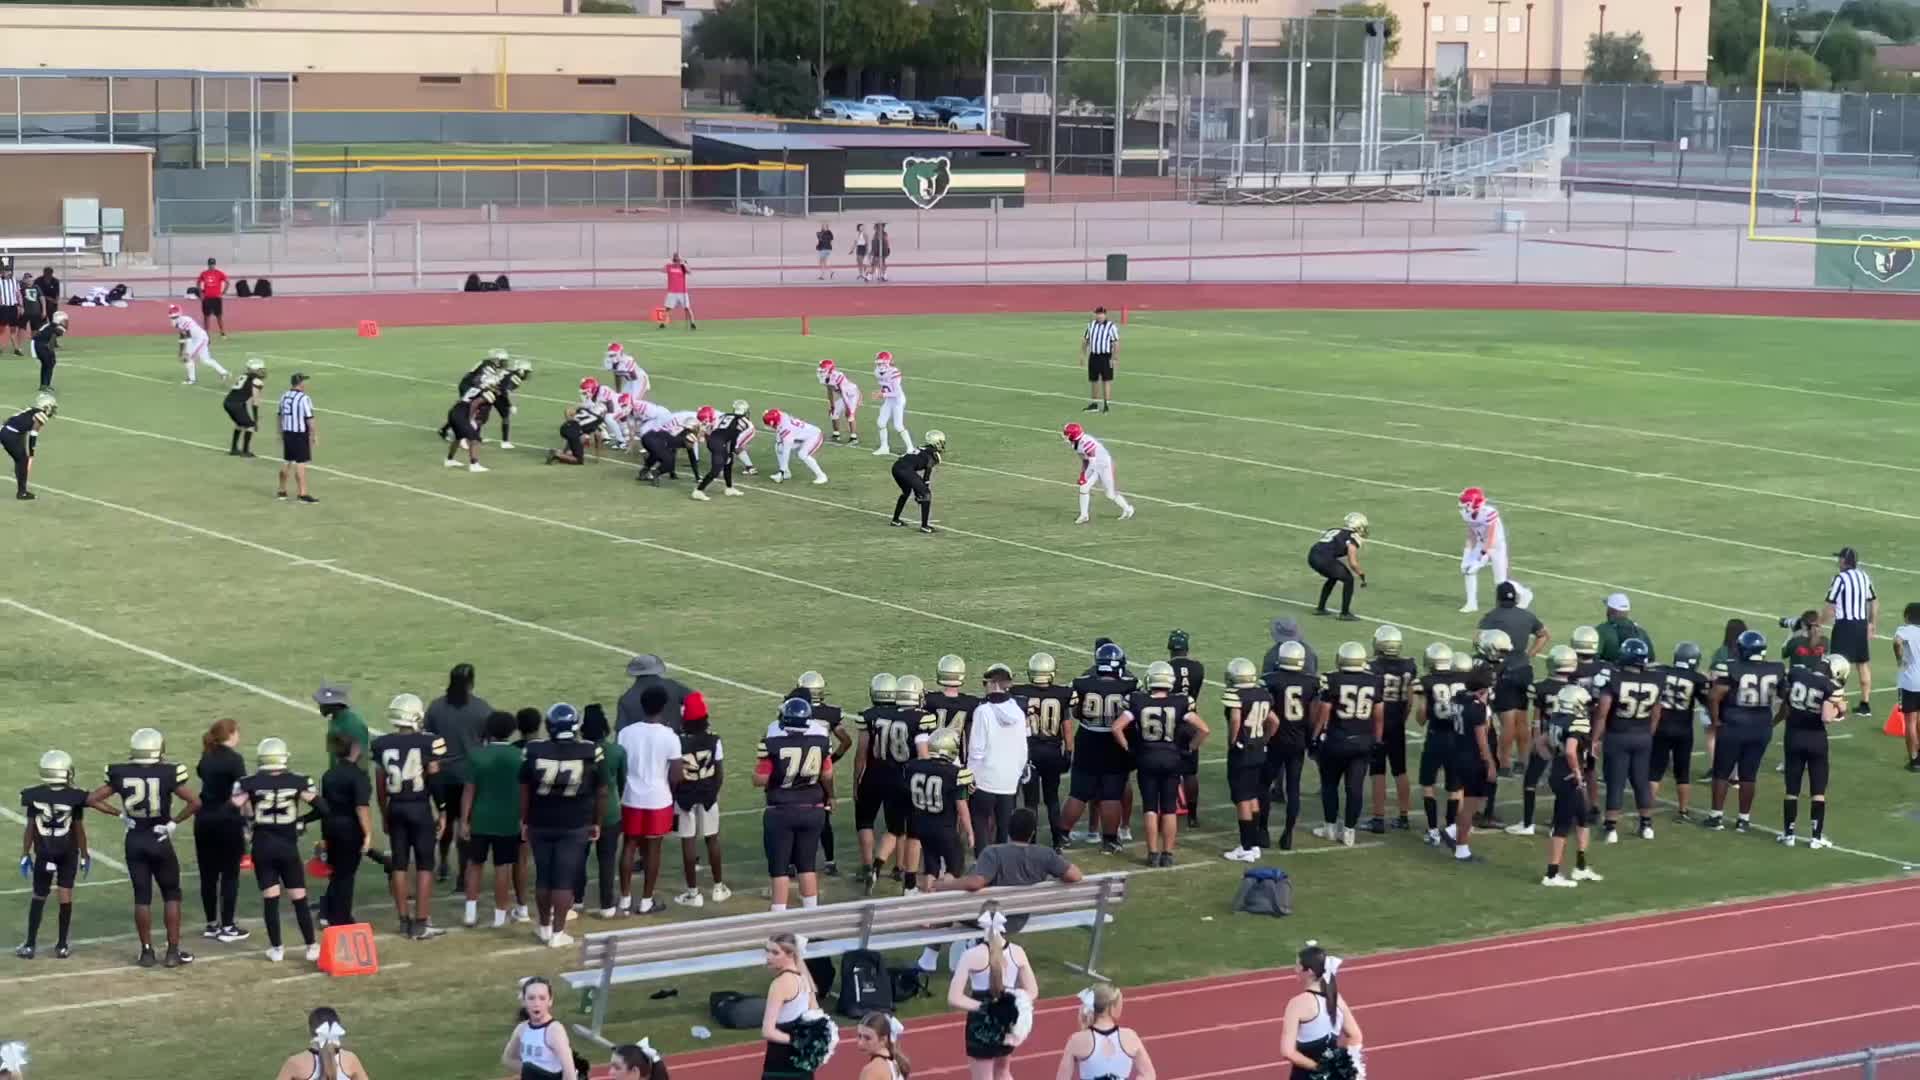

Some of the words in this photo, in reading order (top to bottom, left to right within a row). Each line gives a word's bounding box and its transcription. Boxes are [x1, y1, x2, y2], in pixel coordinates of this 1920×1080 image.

[1284, 685, 1303, 721] 6
[1335, 685, 1374, 719] 56
[1615, 681, 1659, 718] 52
[874, 719, 909, 762] 78
[1141, 706, 1175, 742] 61
[535, 757, 583, 796] 77
[780, 745, 822, 788] 74
[122, 777, 160, 817] 21
[255, 788, 299, 824] 25
[911, 772, 943, 813] 60
[335, 930, 373, 967] 40
